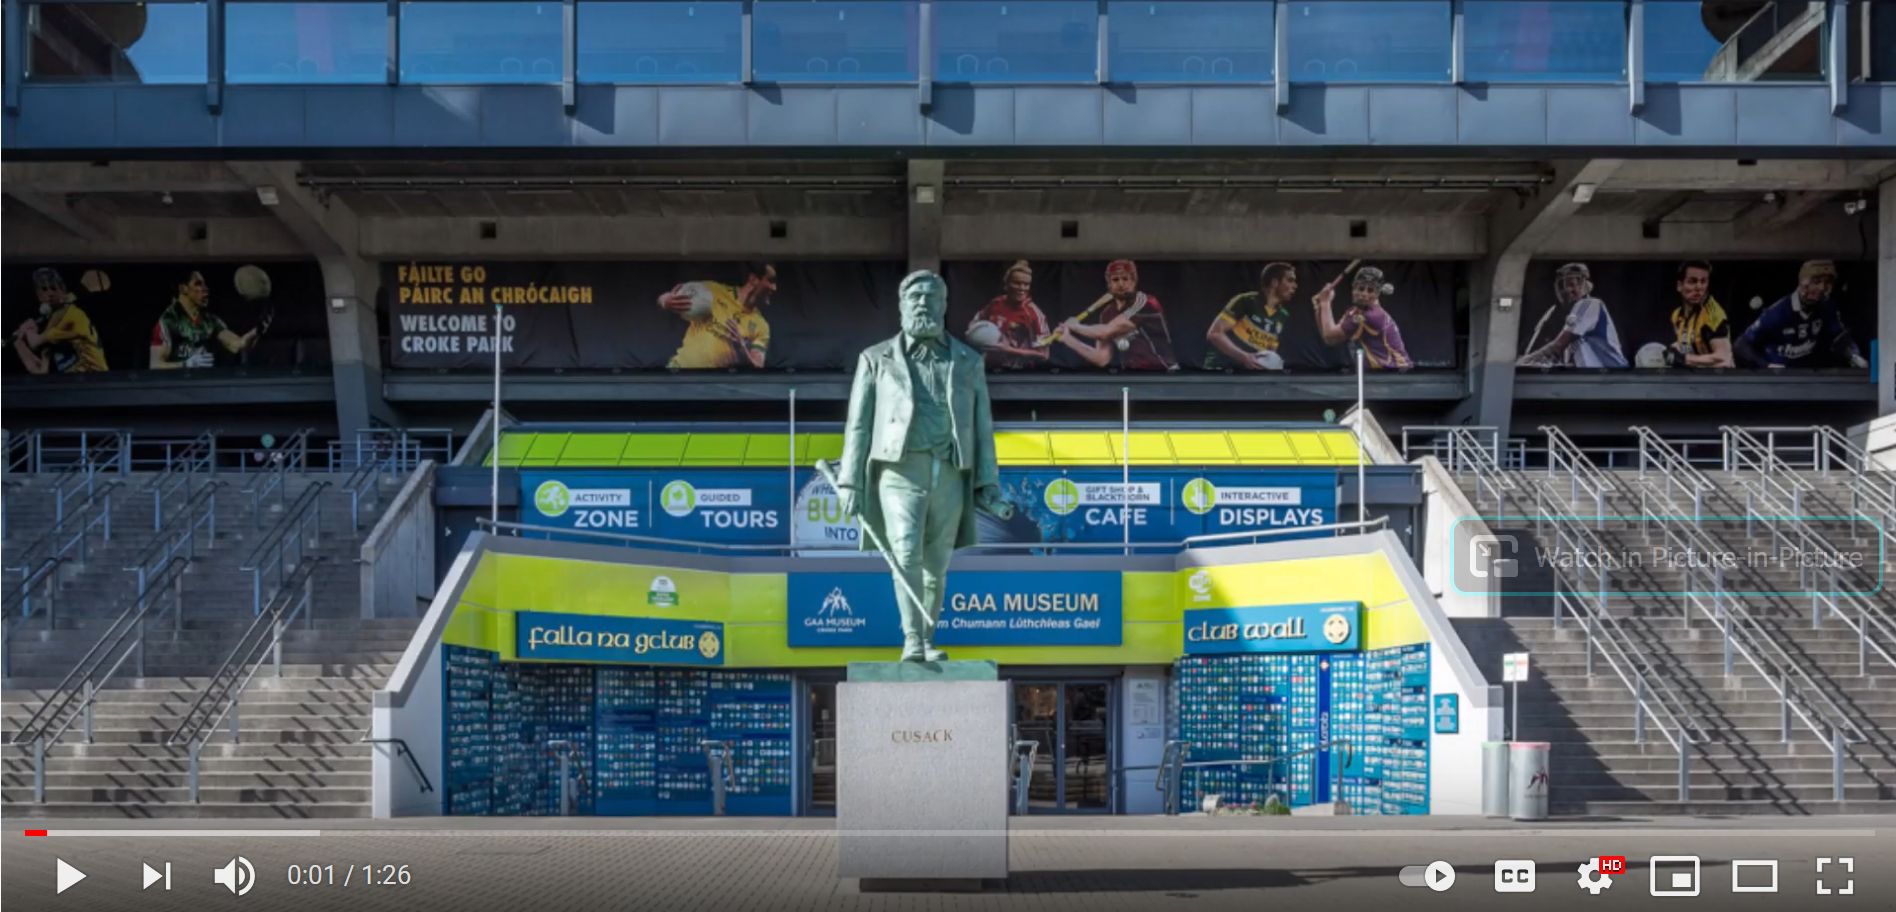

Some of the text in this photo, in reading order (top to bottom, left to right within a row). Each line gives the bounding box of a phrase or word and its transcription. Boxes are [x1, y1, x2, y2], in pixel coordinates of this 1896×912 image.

[398, 261, 485, 284] FÁILTE GO
[400, 282, 592, 304] PÁIRC AN CHRÓCAIGH
[400, 314, 487, 332] WELCOME
[401, 335, 460, 353] CROKE
[574, 493, 622, 502] ACTIVITY
[700, 493, 741, 502] GUIDED
[1086, 485, 1107, 493] GIFT
[1221, 491, 1289, 501] INTERACTIVE
[574, 509, 639, 527] ZONE
[700, 509, 778, 528] TOURS
[1085, 508, 1148, 525] CAFE
[1220, 508, 1324, 525] DISPLAYS
[824, 526, 859, 541] INTO
[951, 592, 1099, 612] GAA MUSEUM
[803, 617, 867, 627] GAA MUSEUM
[951, 616, 1007, 629] Chumann
[1073, 616, 1101, 629] Gael
[597, 631, 630, 648] na
[891, 728, 954, 743] CUSACK
